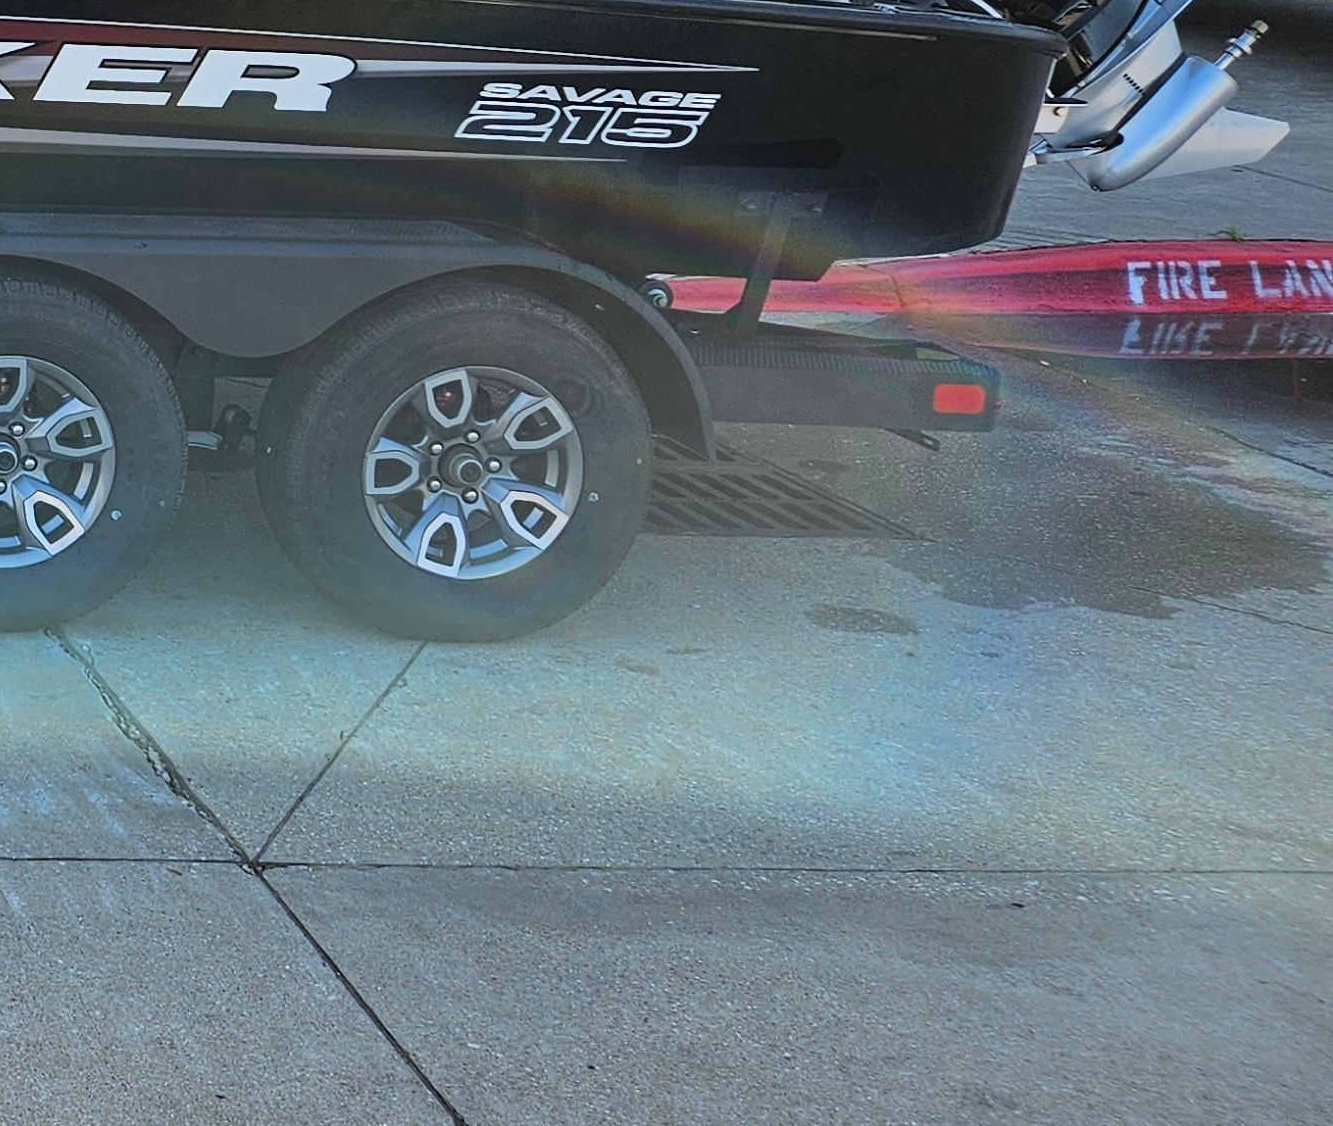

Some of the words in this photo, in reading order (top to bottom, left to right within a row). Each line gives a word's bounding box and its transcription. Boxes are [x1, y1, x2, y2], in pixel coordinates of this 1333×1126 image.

[478, 81, 722, 111] SAVAGE
[454, 100, 710, 150] 215
[1126, 259, 1228, 305] FIRE
[1247, 259, 1333, 299] LAN
